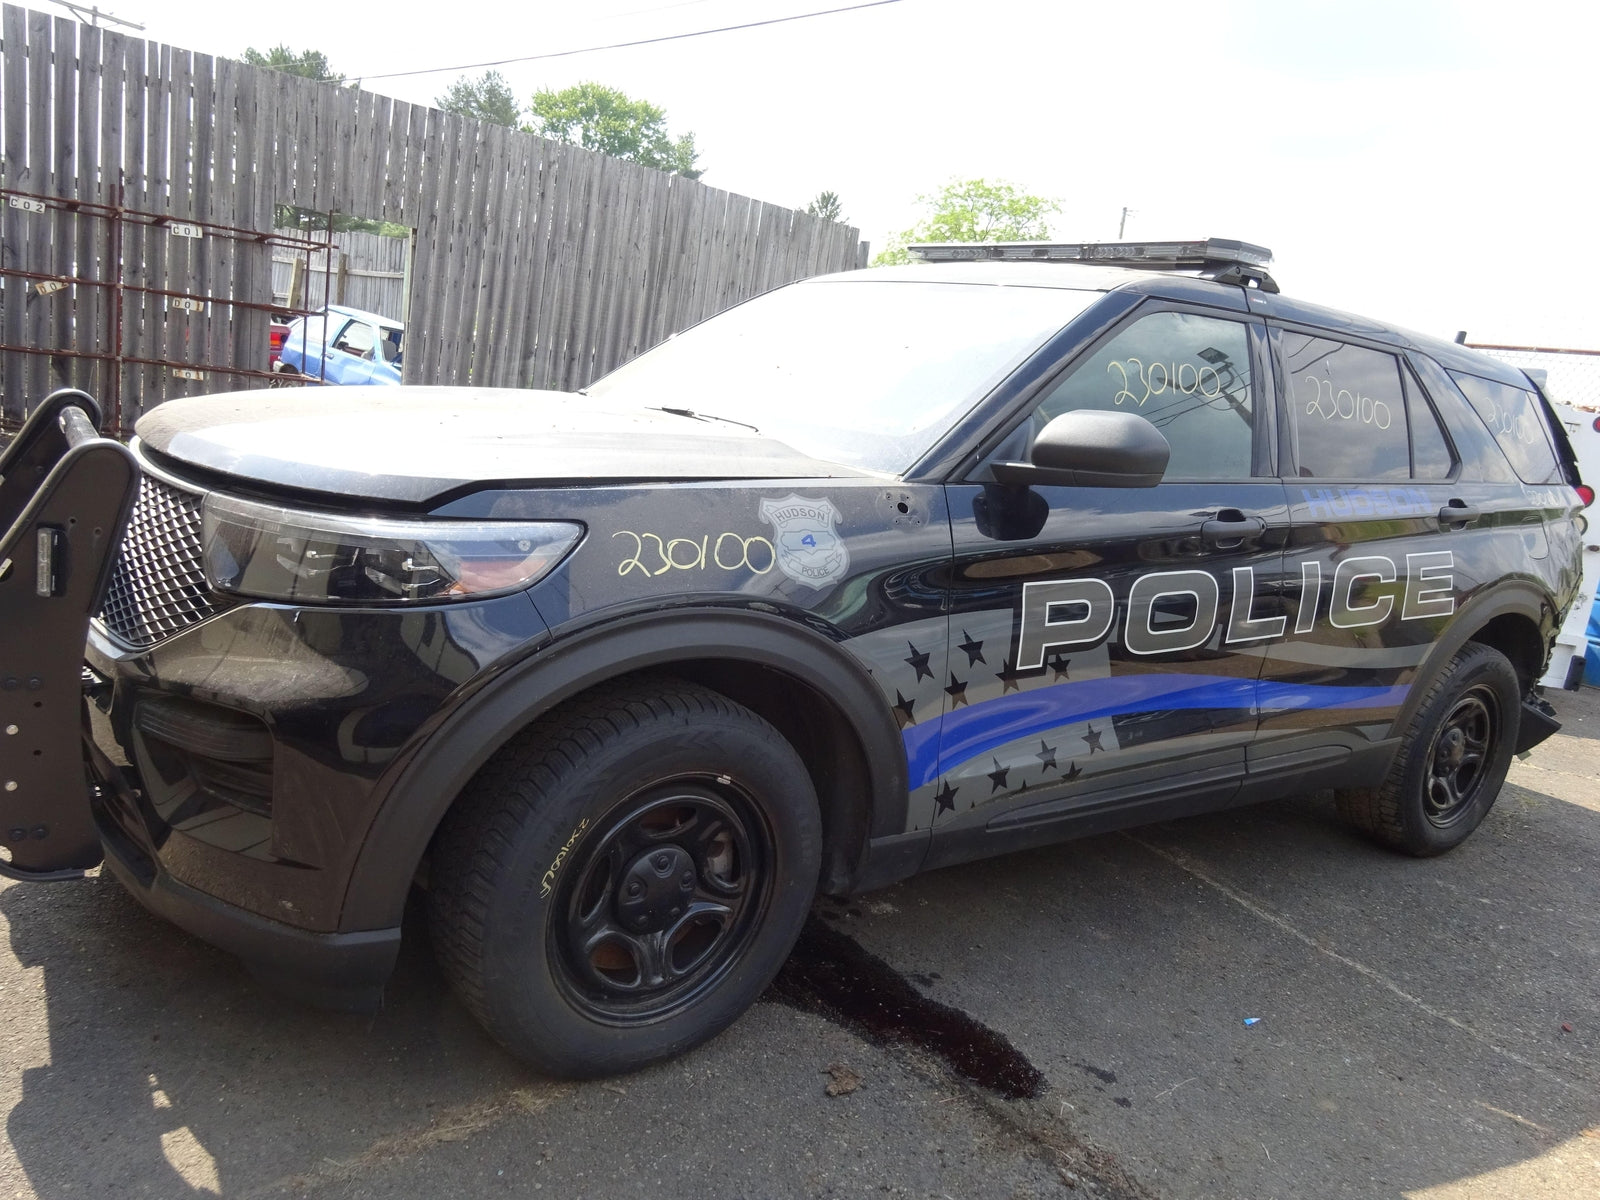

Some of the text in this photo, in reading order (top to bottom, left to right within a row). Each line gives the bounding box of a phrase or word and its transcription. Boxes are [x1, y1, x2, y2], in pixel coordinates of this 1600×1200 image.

[1106, 358, 1221, 407] 230100
[1304, 375, 1392, 430] 230100
[774, 507, 826, 521] HUDSON
[1300, 486, 1433, 518] HUDSON
[611, 530, 776, 578] 230100
[801, 533, 817, 548] 4
[801, 566, 830, 577] POLICE
[1015, 550, 1456, 671] POLICE
